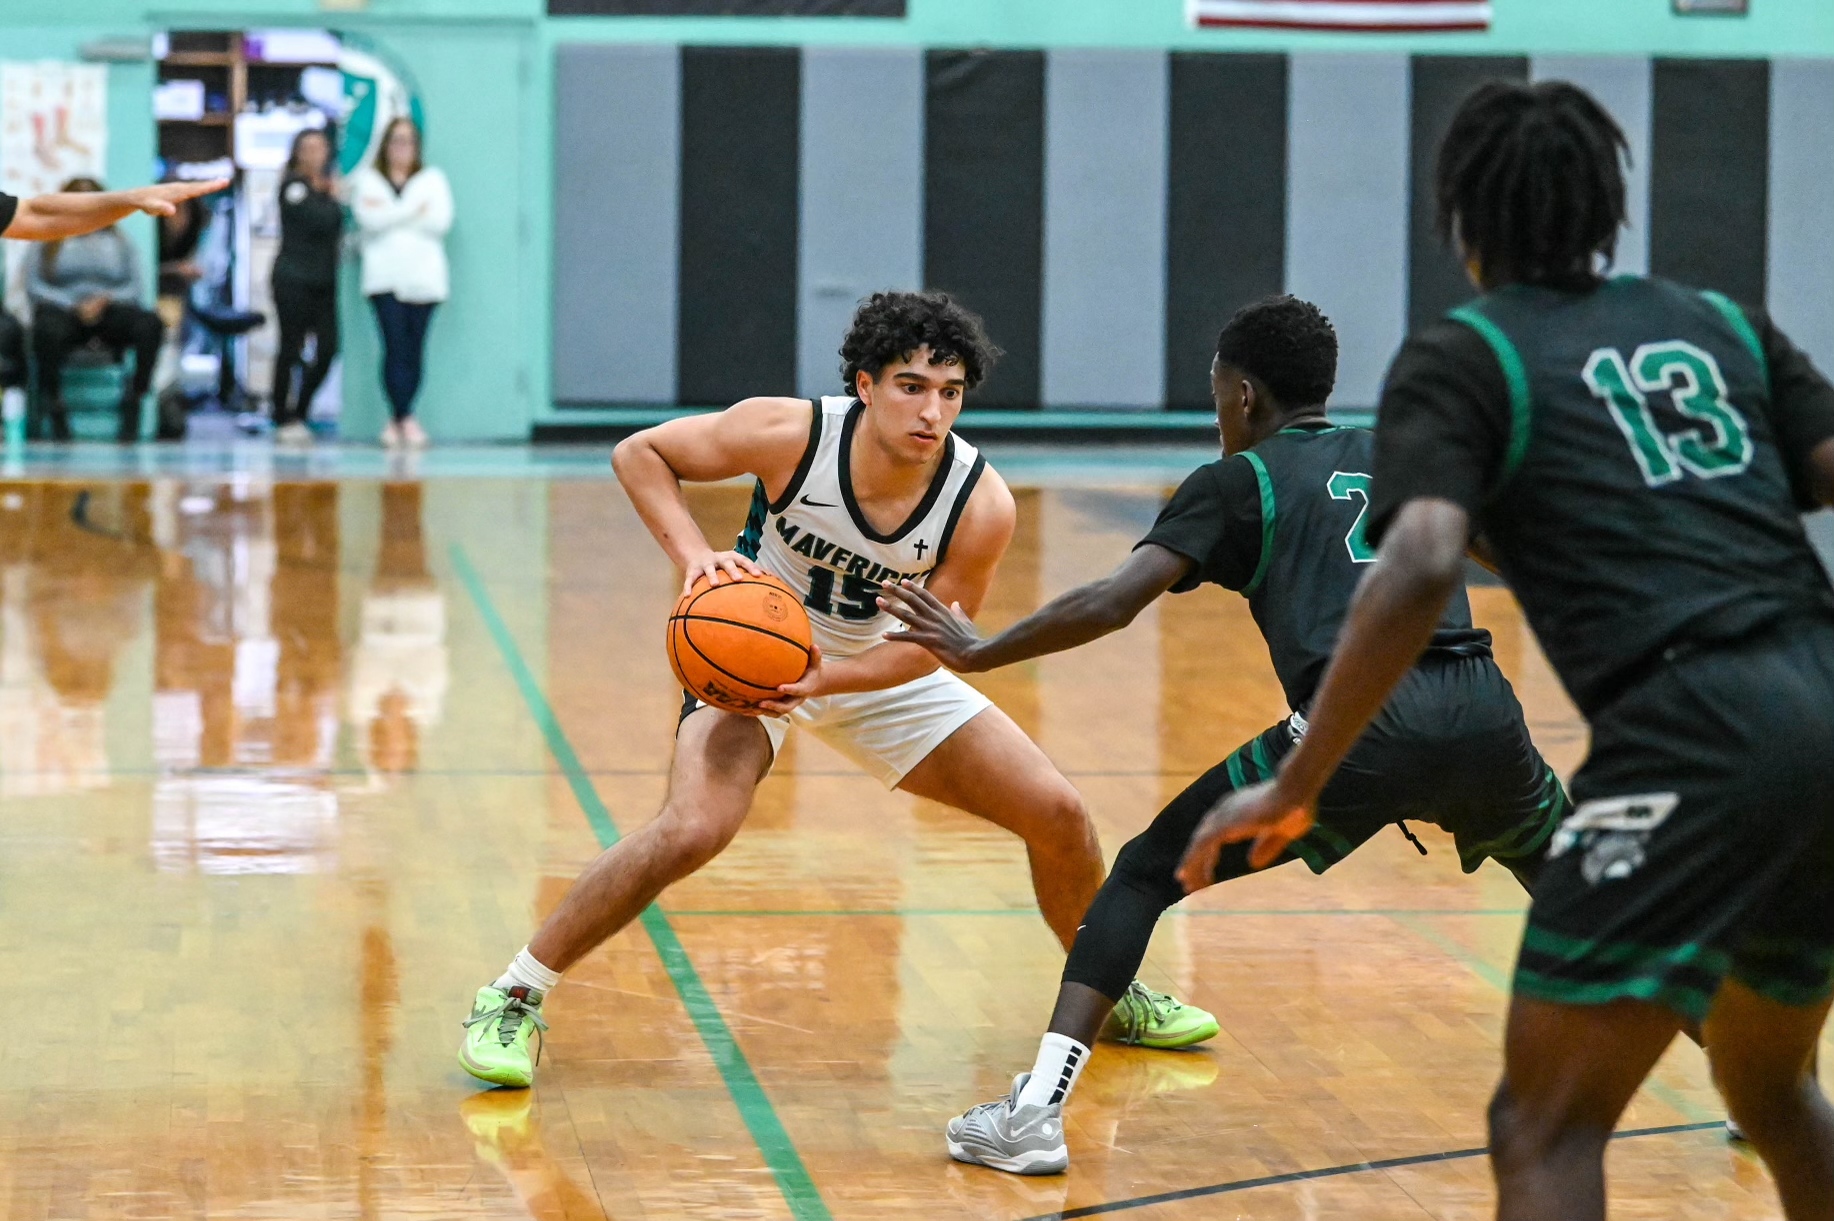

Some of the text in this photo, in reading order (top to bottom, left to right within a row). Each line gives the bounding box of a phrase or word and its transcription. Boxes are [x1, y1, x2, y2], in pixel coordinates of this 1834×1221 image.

[1581, 339, 1754, 488] 13
[1326, 471, 1380, 563] 2
[803, 564, 885, 621] 15
